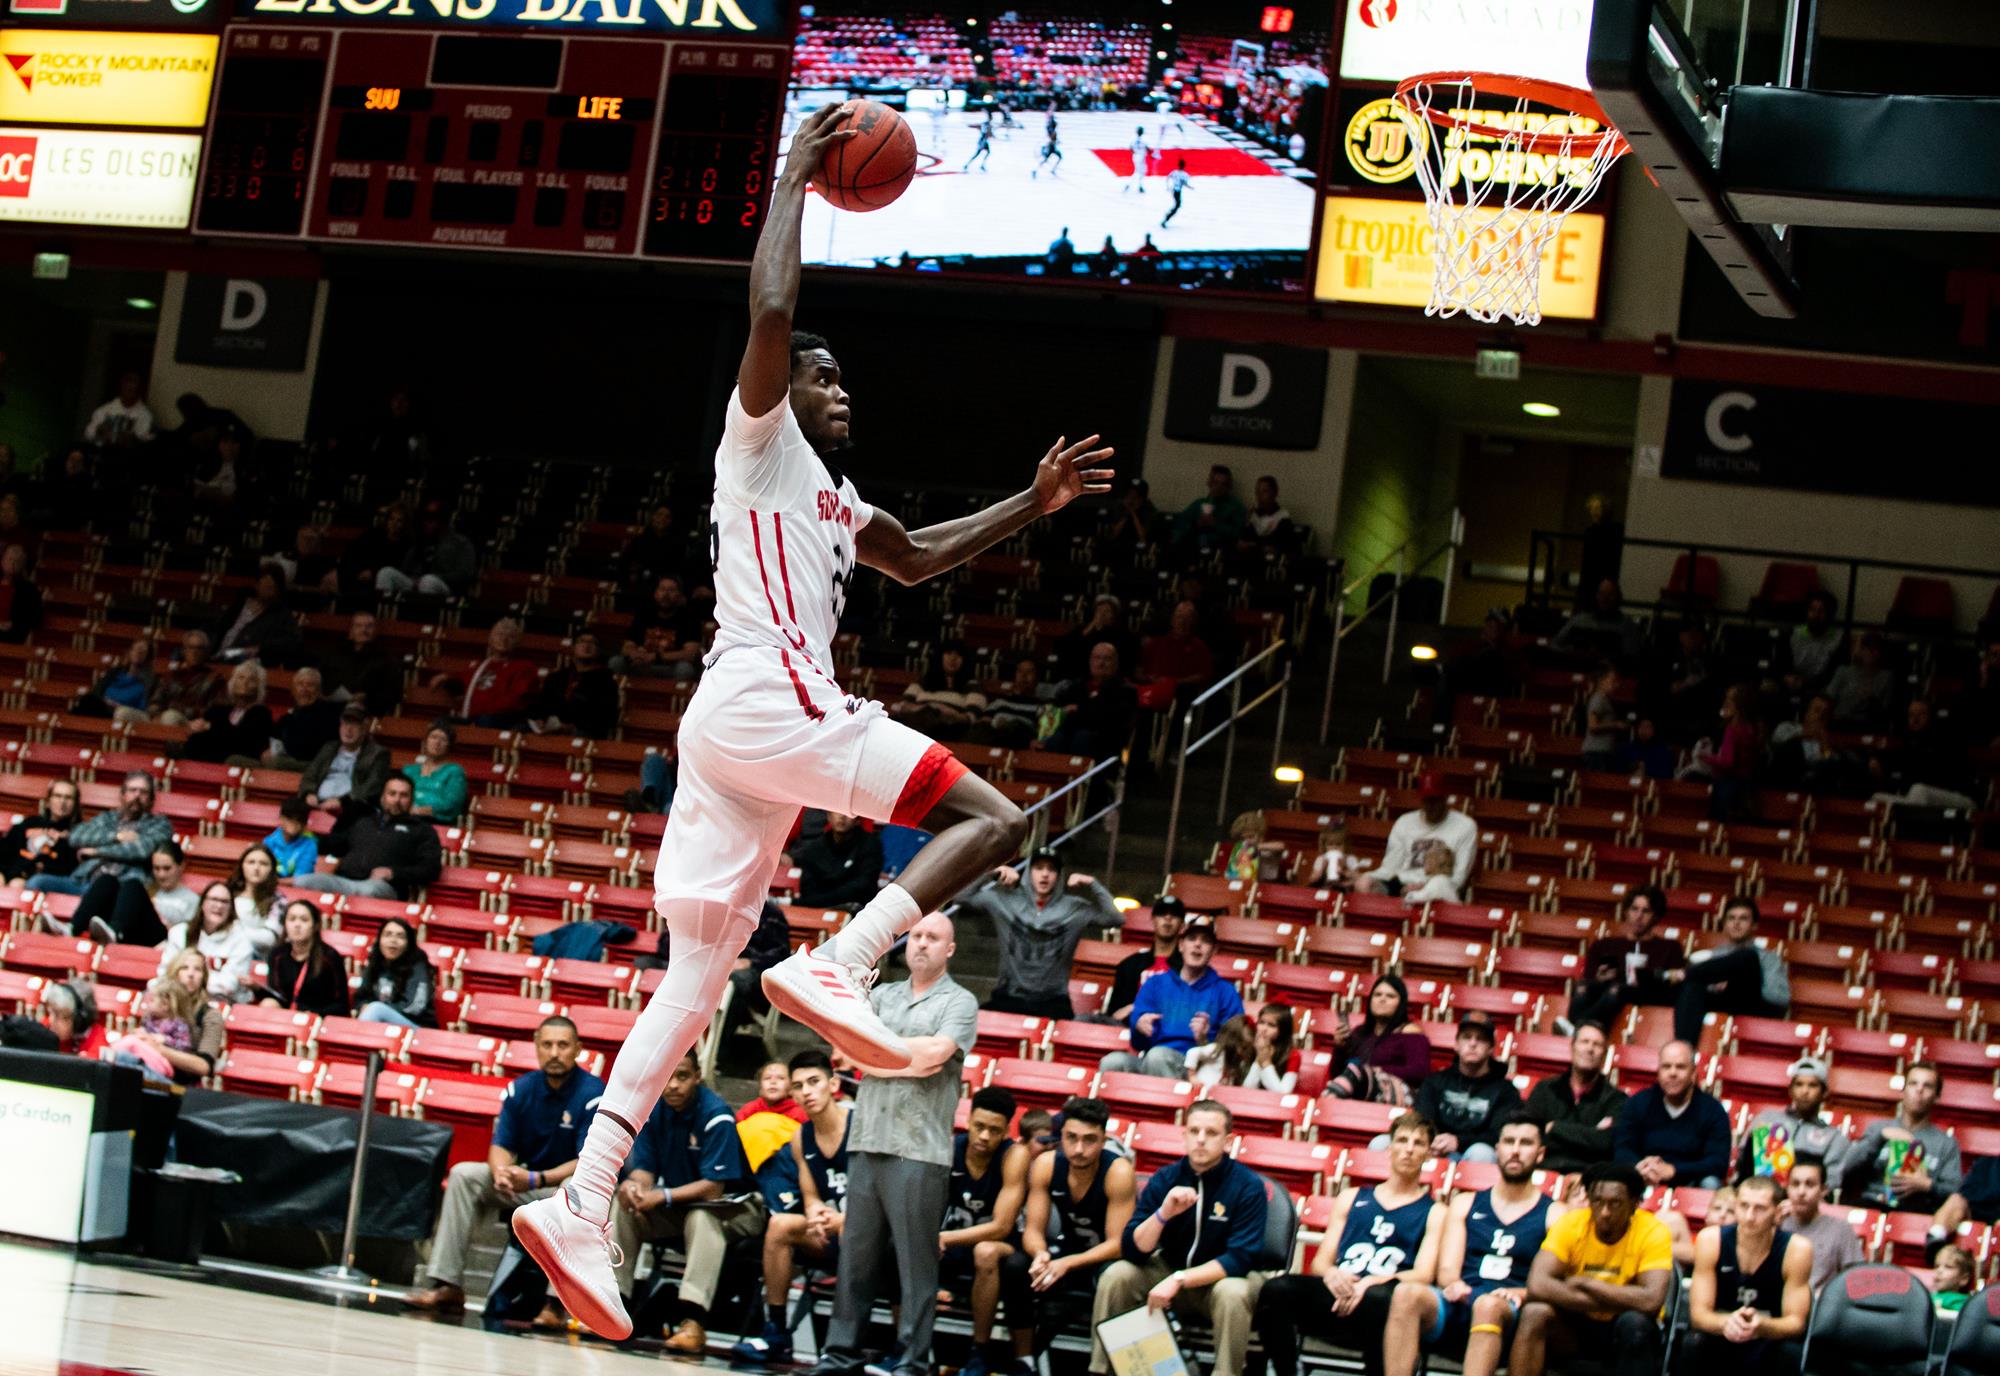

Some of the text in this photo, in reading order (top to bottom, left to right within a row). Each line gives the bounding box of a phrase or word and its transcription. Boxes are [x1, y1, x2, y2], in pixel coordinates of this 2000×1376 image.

[1413, 0, 1584, 32] RAMAD
[40, 53, 210, 73] ROCKY MOUNTAIN
[37, 70, 102, 87] POWER
[364, 87, 400, 110] SUU
[577, 95, 624, 120] LIFE
[466, 103, 512, 120] PERIOD
[48, 147, 95, 174] LES
[106, 148, 197, 178] OLSON
[329, 162, 372, 179] FOULS
[1440, 148, 1595, 188] JOHN'S
[432, 166, 524, 187] FOUL PLAYER
[584, 175, 628, 192] FOULS
[432, 226, 507, 245] ADVANTAGE
[220, 278, 267, 330] D
[1216, 352, 1272, 410] D
[1208, 414, 1273, 433] SECTION
[1704, 390, 1757, 452] C
[12, 1102, 72, 1126] Cardon
